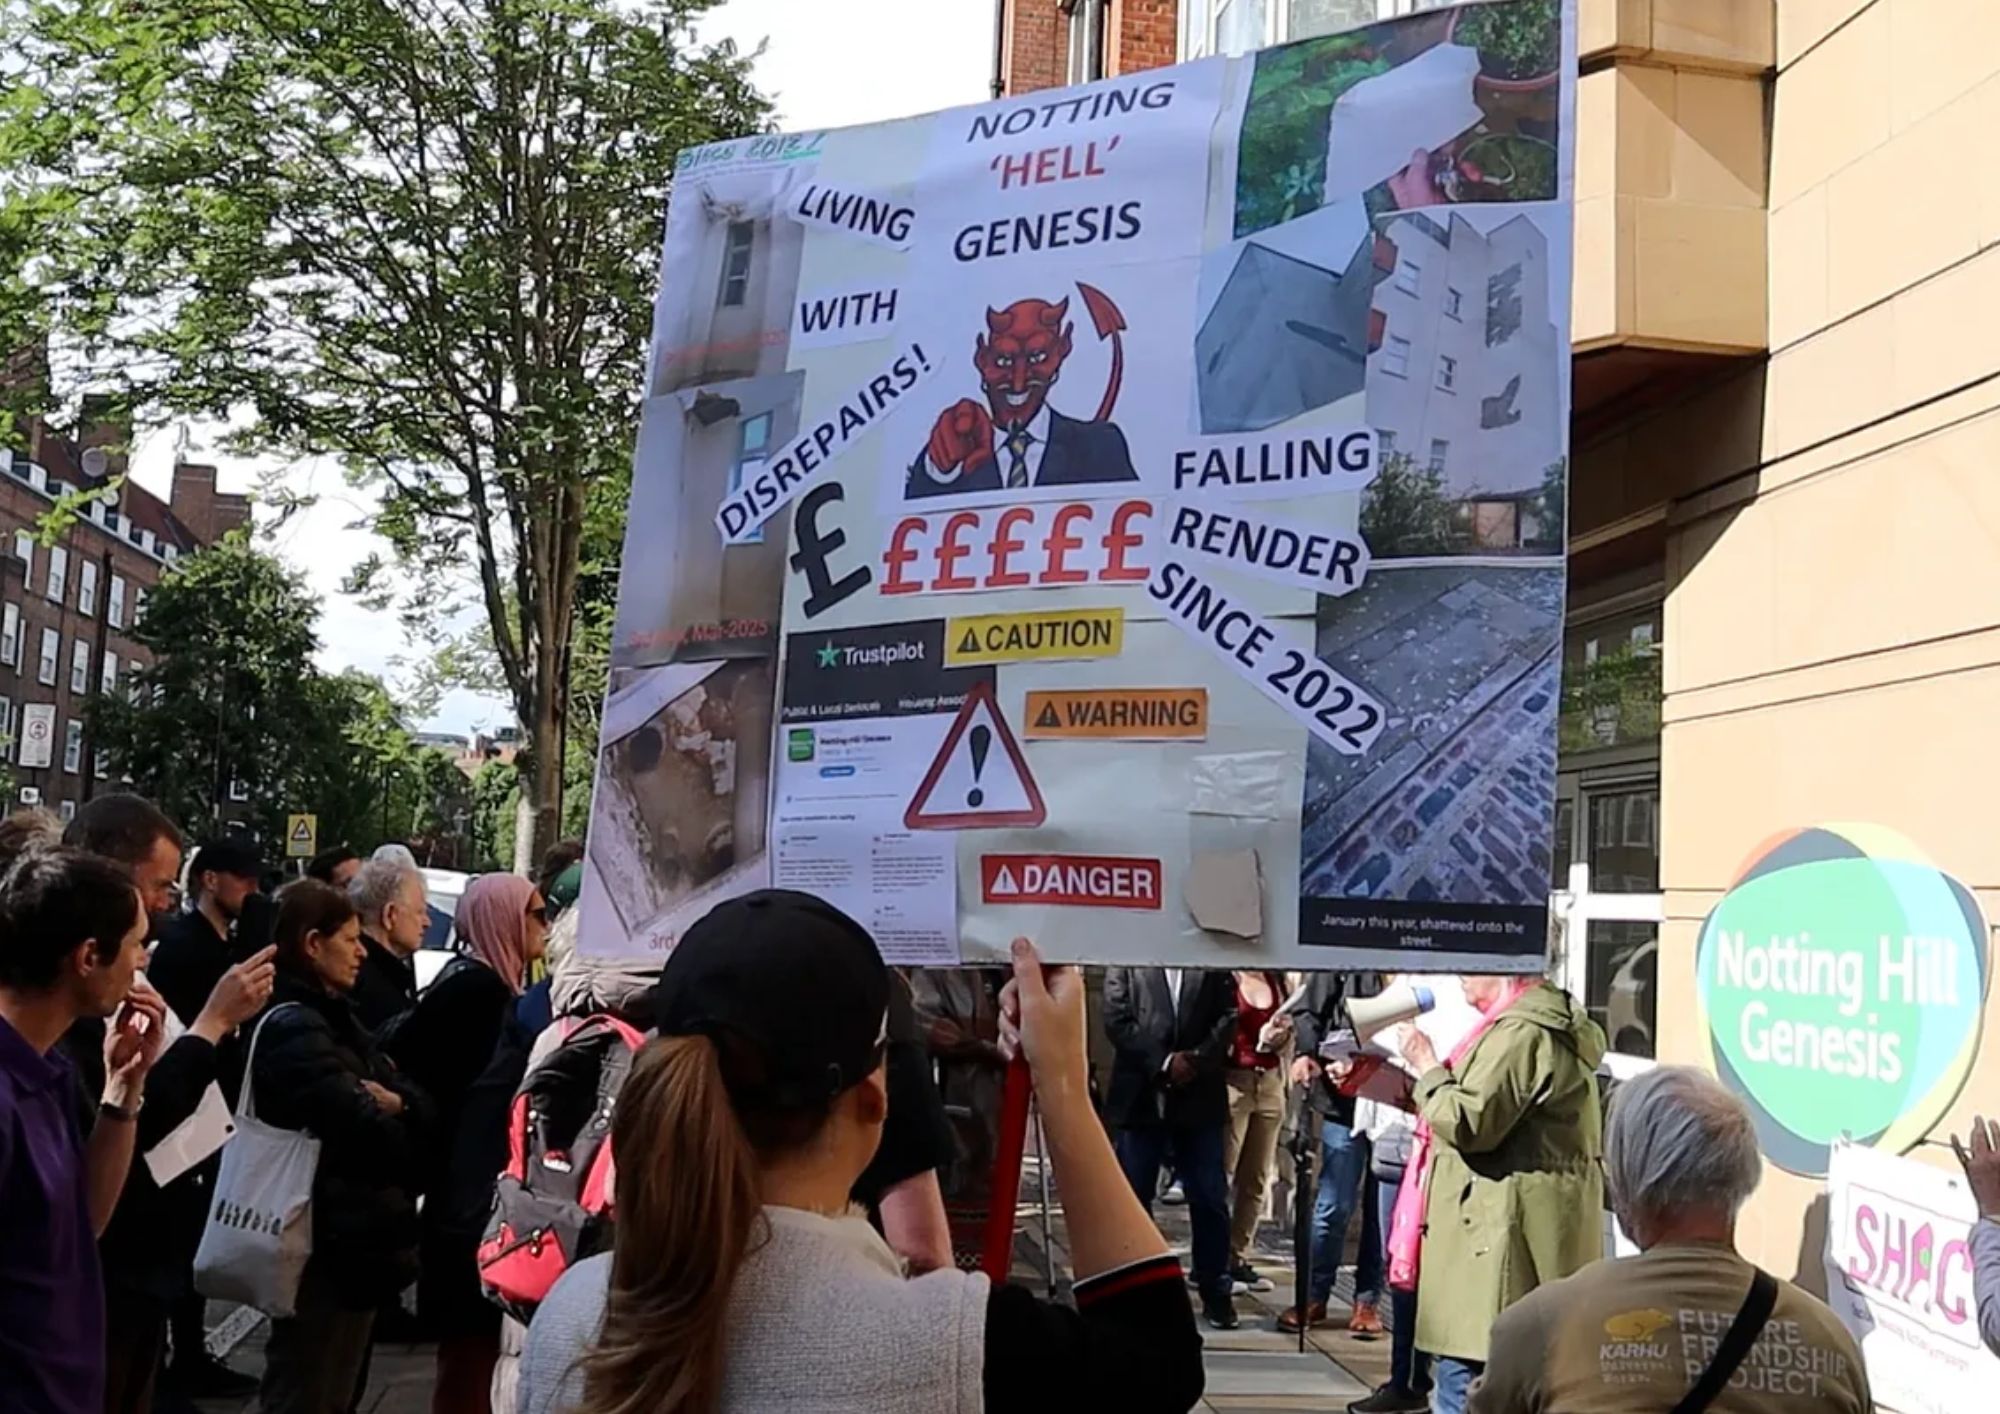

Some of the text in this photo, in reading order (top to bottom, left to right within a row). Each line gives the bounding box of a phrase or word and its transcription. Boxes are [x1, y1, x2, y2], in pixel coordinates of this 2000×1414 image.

[967, 82, 1176, 143] NOTTING
[798, 183, 916, 243] LIVING
[953, 201, 1142, 262] GENESIS
[800, 288, 898, 333] WITH
[718, 342, 932, 539] DISREPAIRS!
[1174, 430, 1372, 490] FALLING
[1169, 506, 1361, 586] RENDER
[844, 641, 925, 666] Trustpilot
[985, 618, 1113, 654] CAUTION
[1148, 561, 1380, 751] SINCE 2022
[1067, 699, 1199, 728] WARNING
[1022, 867, 1154, 900] DANGER
[1321, 913, 1367, 931] January
[1367, 914, 1390, 929] this
[1420, 916, 1474, 933] shattered
[1476, 920, 1503, 933] onto
[1504, 921, 1525, 935] the
[1717, 929, 1959, 1015] Notting Hill
[1740, 999, 1903, 1083] Genesis
[1600, 1342, 1670, 1360] KARHU
[1678, 1309, 1801, 1345] FUTRE
[1681, 1333, 1847, 1378] FRNDSHIP
